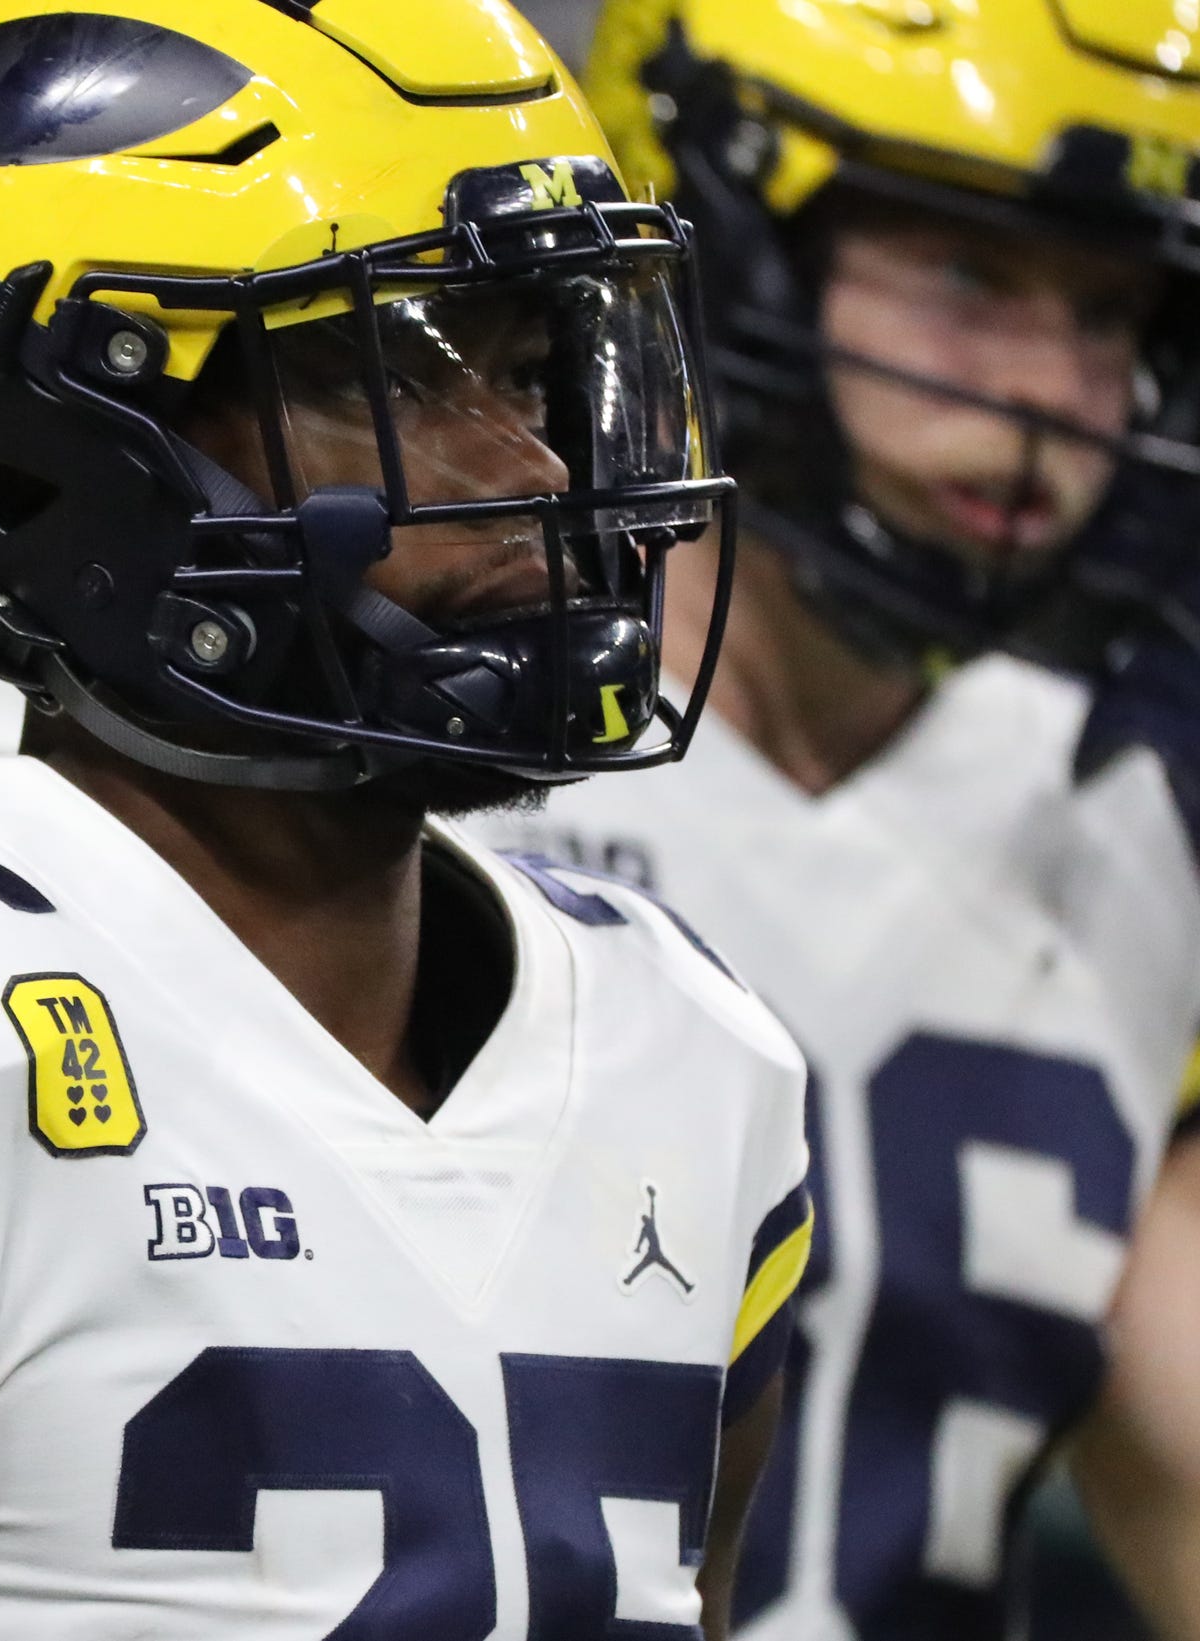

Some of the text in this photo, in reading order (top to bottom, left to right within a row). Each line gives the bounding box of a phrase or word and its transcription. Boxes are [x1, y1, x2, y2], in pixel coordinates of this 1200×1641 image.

[518, 160, 583, 210] M
[35, 996, 93, 1034] TM
[61, 1038, 107, 1080] 42
